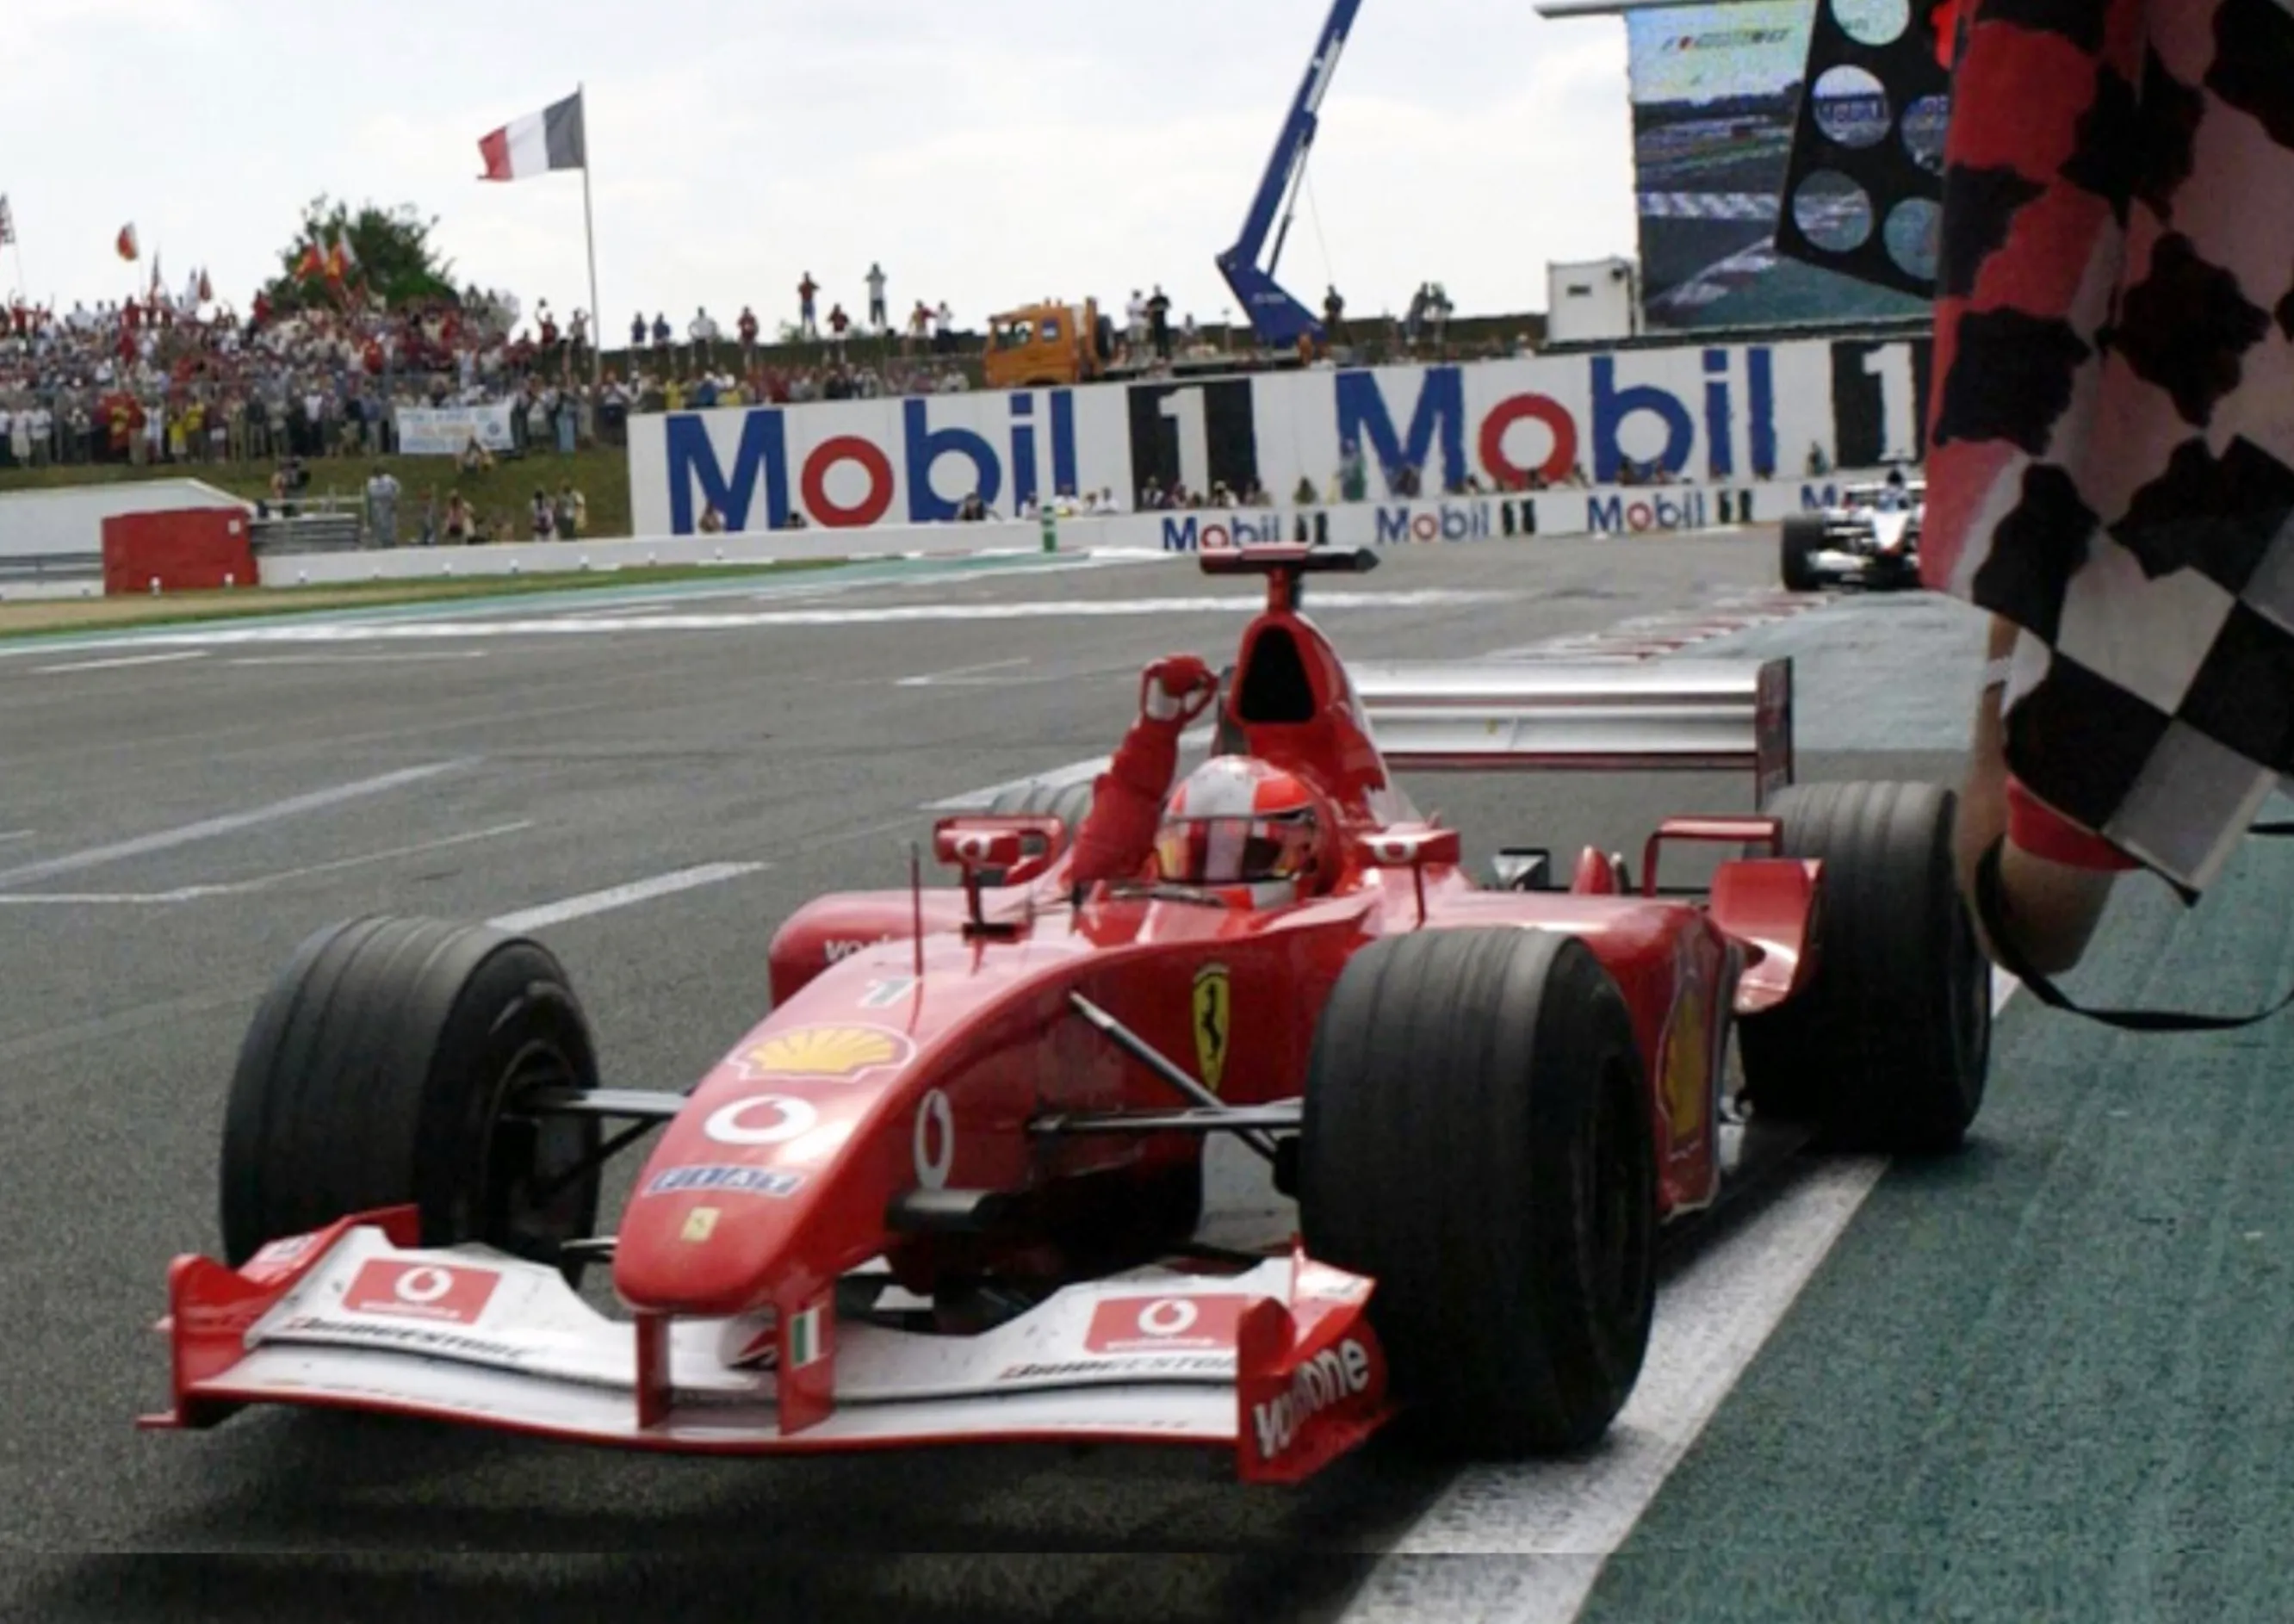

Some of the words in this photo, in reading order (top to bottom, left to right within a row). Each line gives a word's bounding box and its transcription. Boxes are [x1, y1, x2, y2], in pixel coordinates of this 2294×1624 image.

[1335, 344, 1775, 496] Mobil
[666, 388, 1078, 536] Mobil
[1162, 511, 1281, 552] Mobil
[1375, 499, 1490, 544] Mobil
[1588, 488, 1706, 533] Mobil
